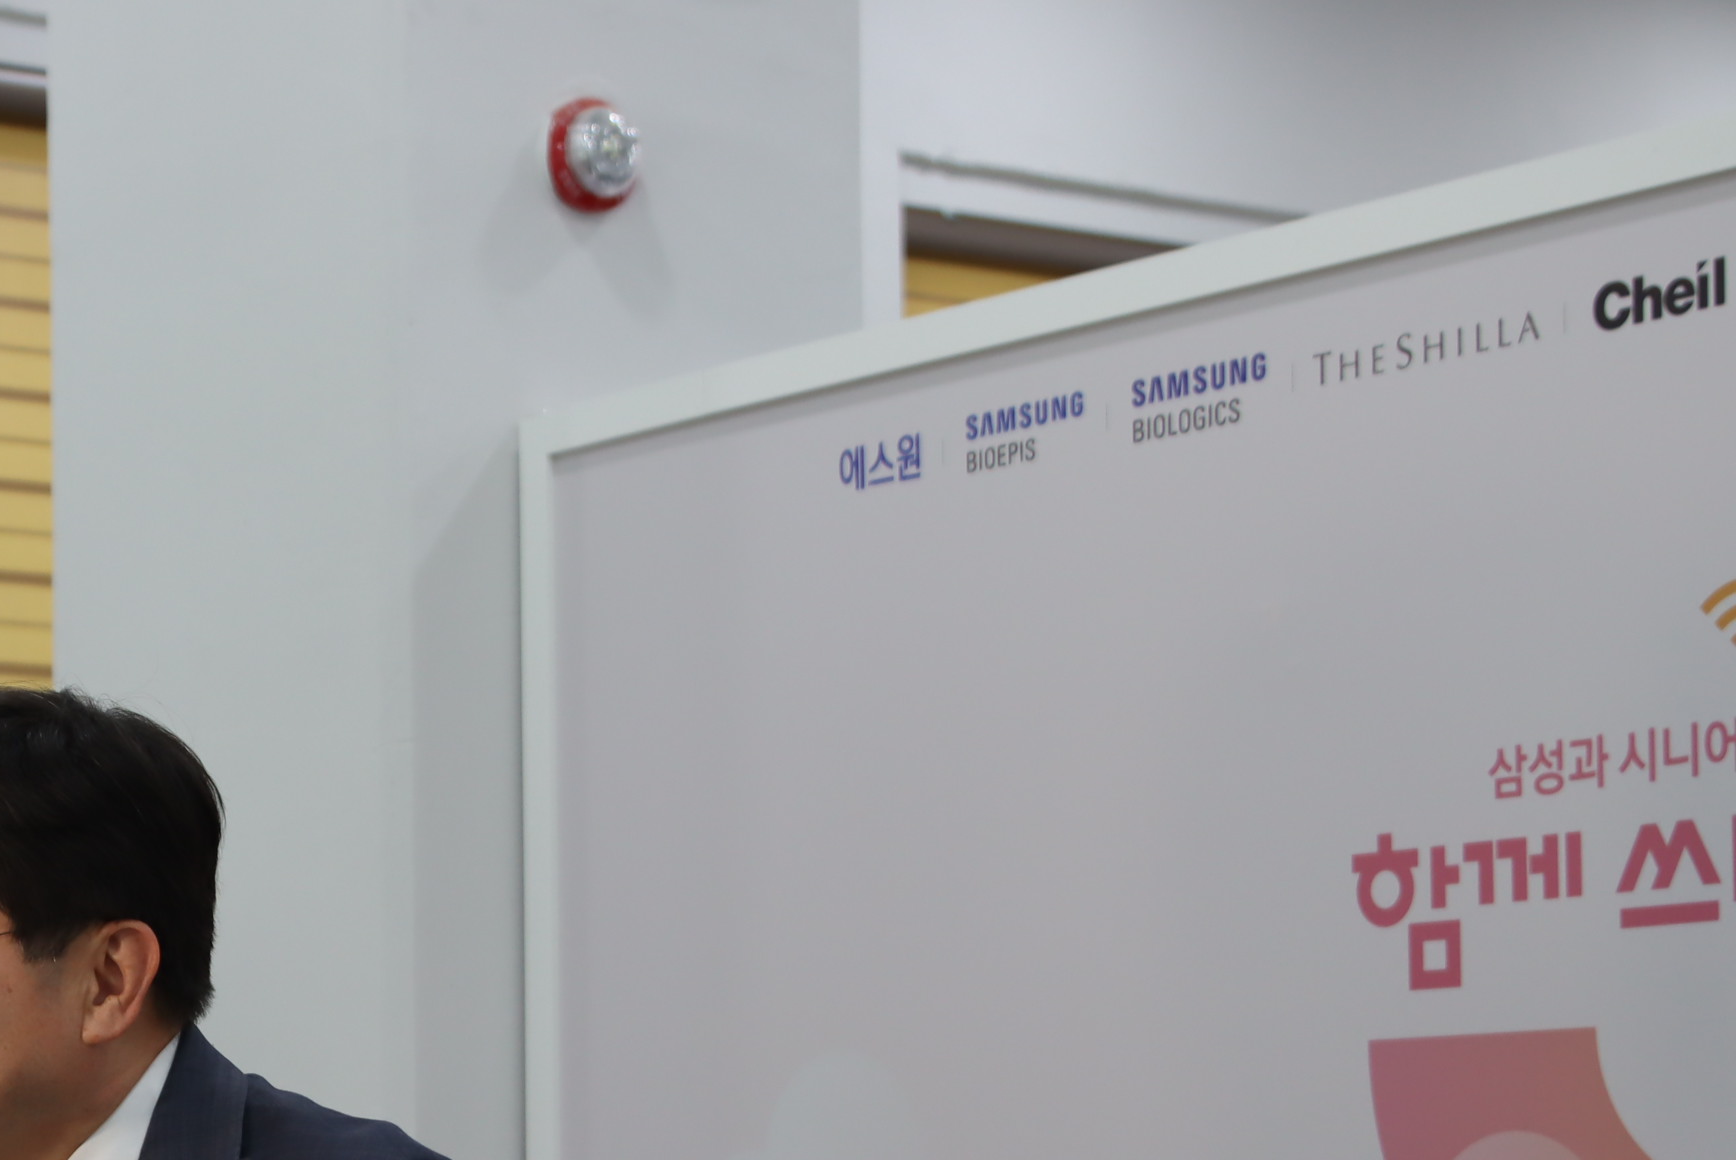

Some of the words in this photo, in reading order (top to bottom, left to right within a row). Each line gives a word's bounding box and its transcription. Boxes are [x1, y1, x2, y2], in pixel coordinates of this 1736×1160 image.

[1131, 352, 1268, 408] SAMSUNG
[965, 391, 1085, 440] SAMSUNG
[1132, 398, 1241, 444] BIOLOGICS
[839, 432, 922, 490] 에스원
[966, 437, 1037, 474] BIOEPIS
[1488, 734, 1609, 800] 삼성과
[1351, 832, 1583, 991] 함께
[1616, 814, 1736, 929] 쓰
